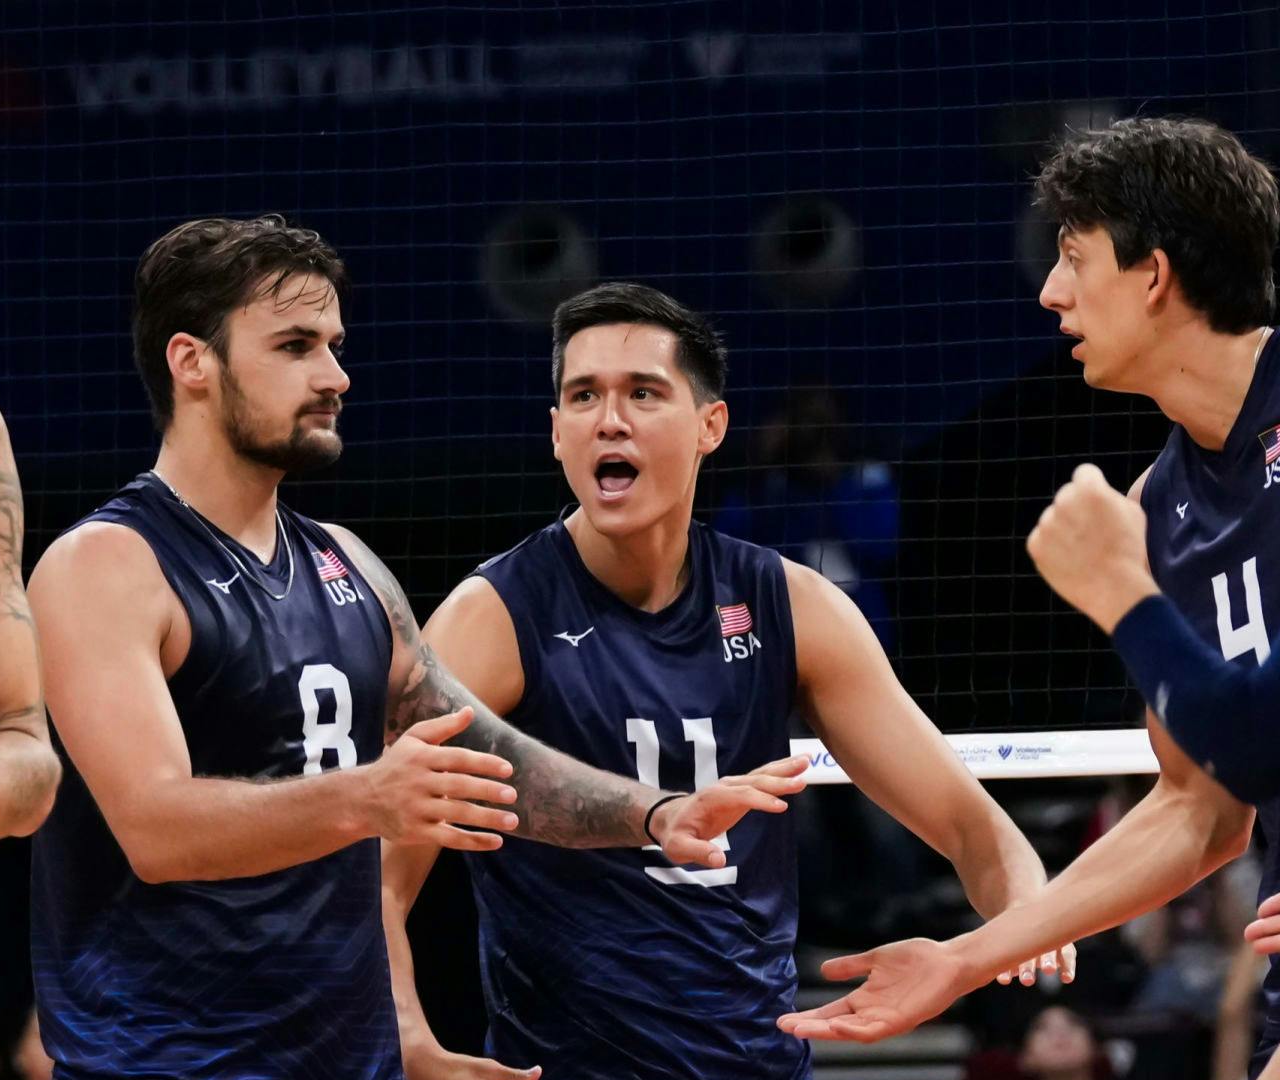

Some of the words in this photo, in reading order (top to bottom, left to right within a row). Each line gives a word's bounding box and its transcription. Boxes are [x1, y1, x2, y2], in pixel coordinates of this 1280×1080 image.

[1211, 556, 1271, 667] 4
[298, 663, 358, 776] 8
[625, 717, 731, 851] 11
